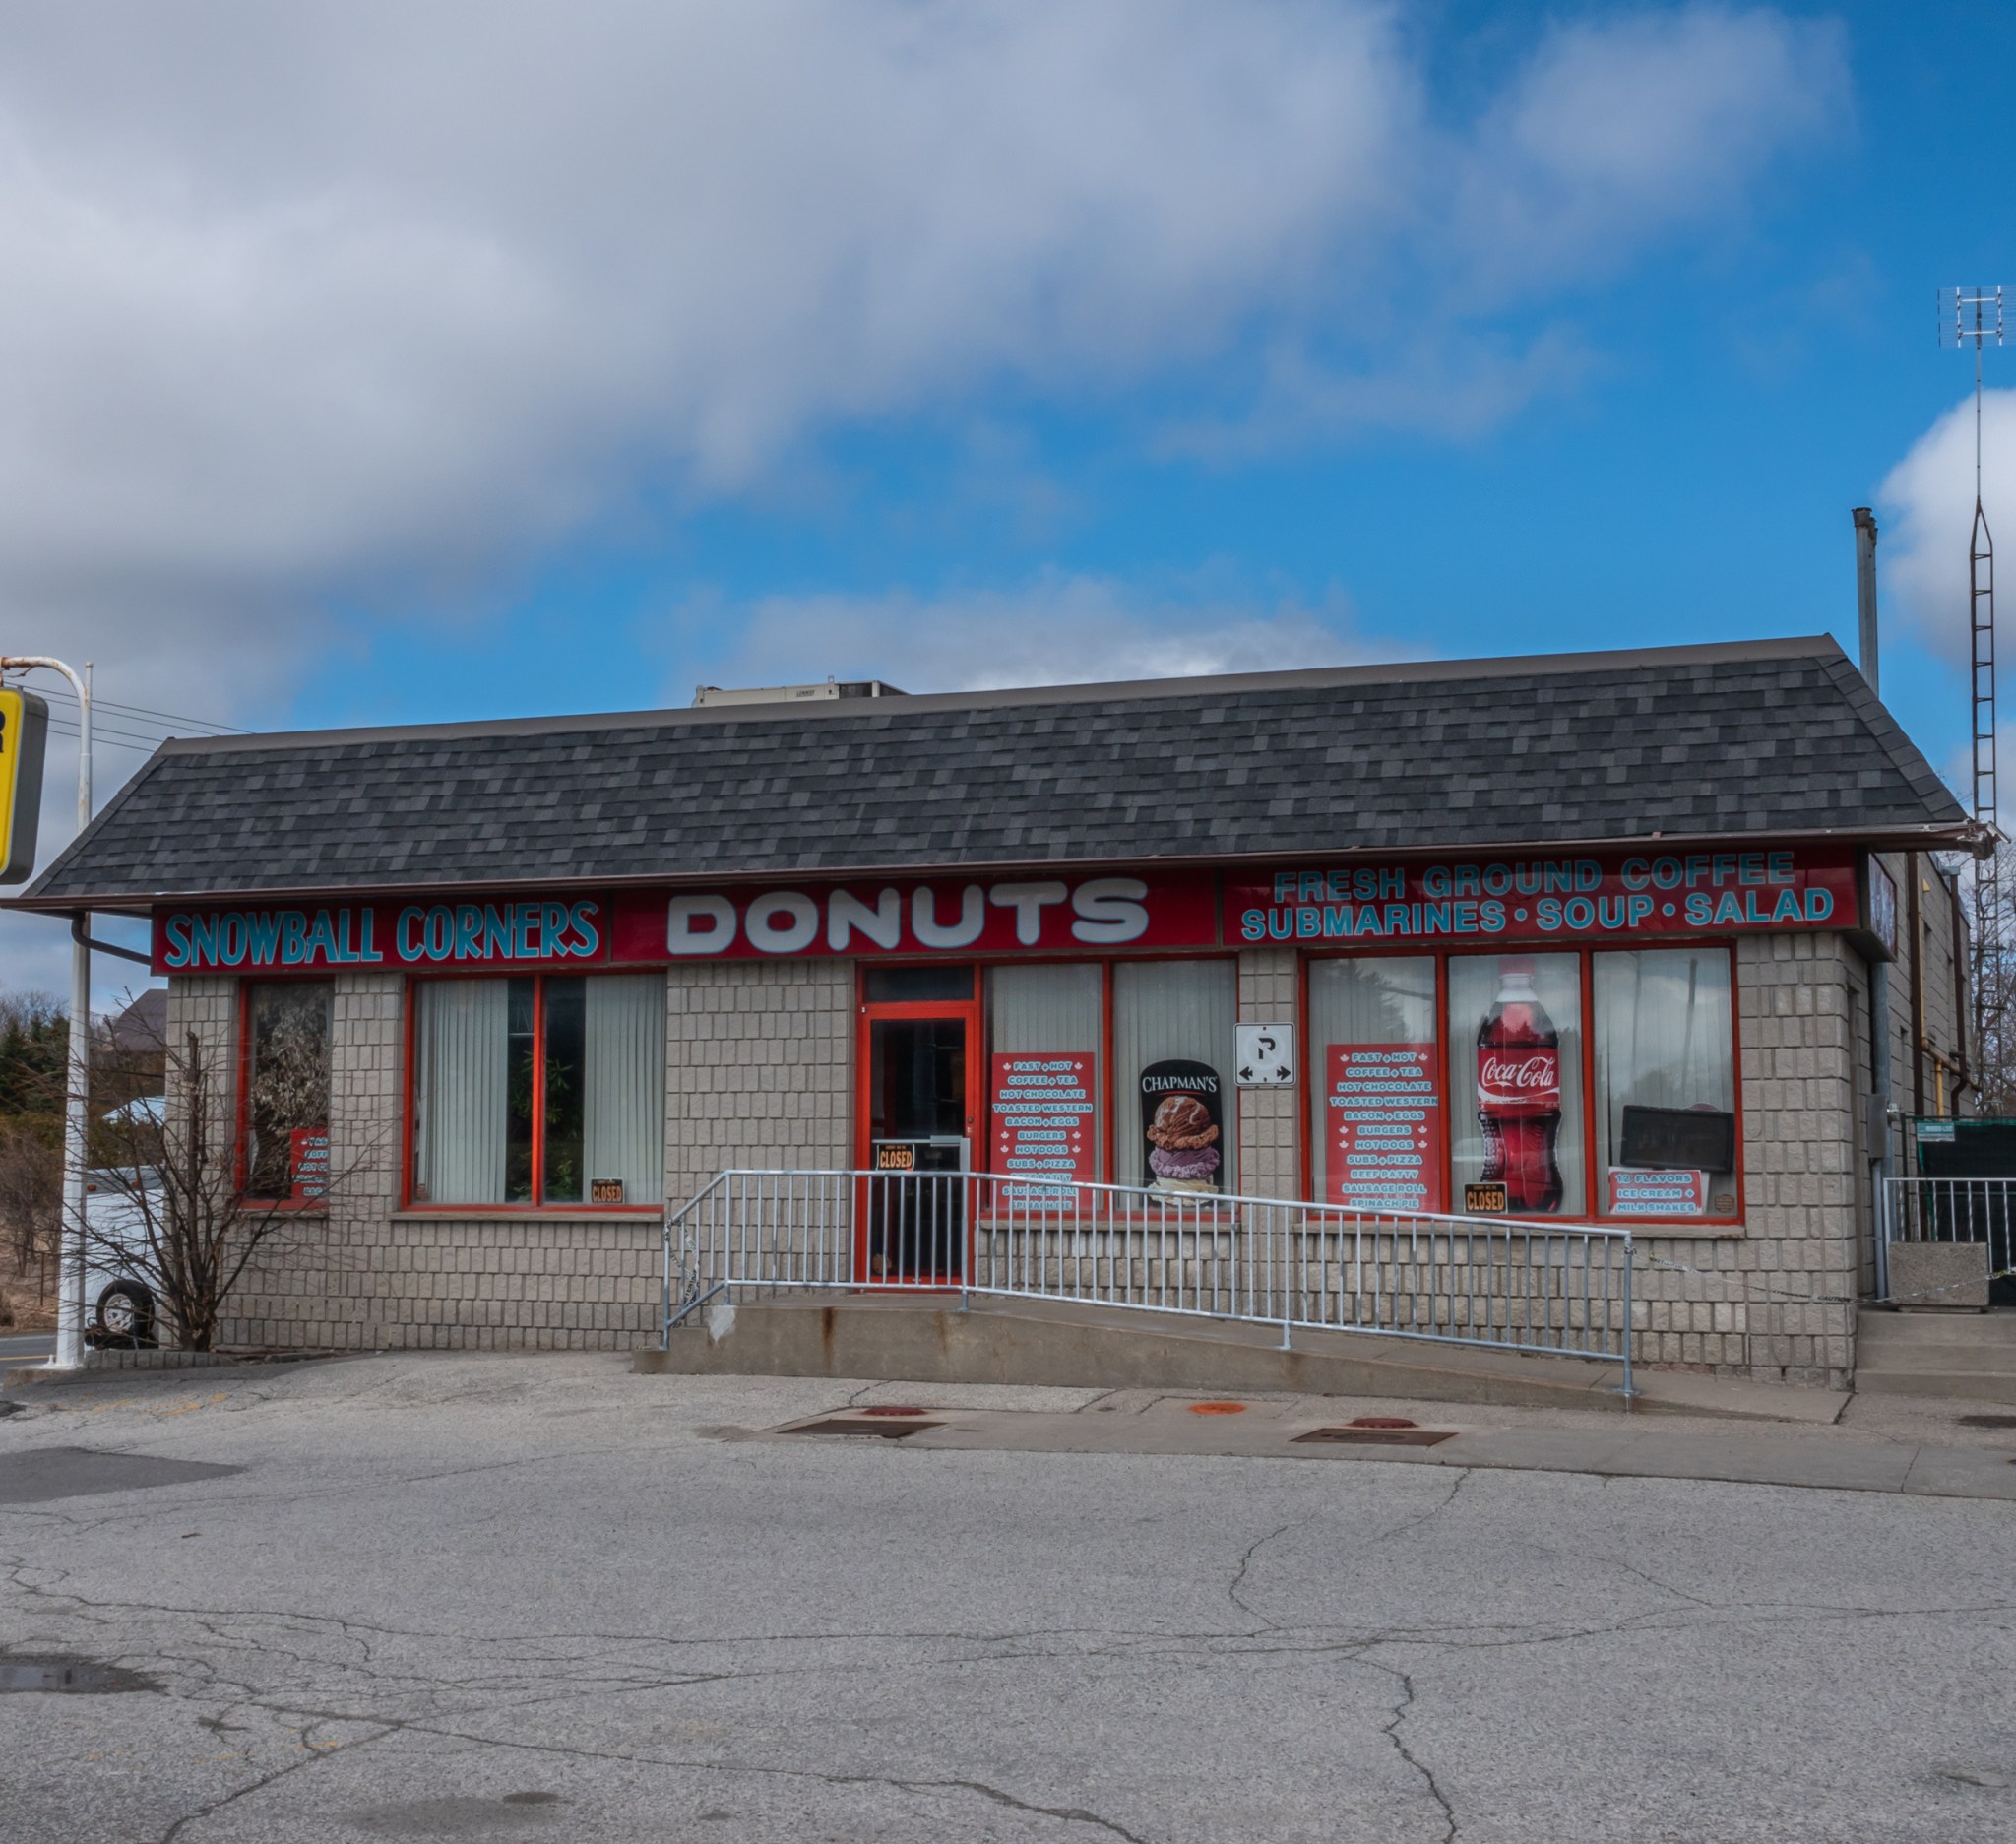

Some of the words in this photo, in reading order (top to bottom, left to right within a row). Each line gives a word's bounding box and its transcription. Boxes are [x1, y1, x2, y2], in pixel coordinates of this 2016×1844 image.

[1274, 867, 1405, 903] FRESH
[1423, 858, 1603, 898] GROUND
[1621, 851, 1796, 891] COFFEE
[666, 877, 1150, 955] DONUTS
[1241, 899, 1507, 940] SUBMARINES
[1536, 894, 1654, 930] SOUP
[1684, 887, 1834, 926] SALAD
[164, 907, 383, 967] SNOWBALL
[396, 901, 599, 962] CORNERS
[1352, 1053, 1382, 1062] FAST
[1391, 1053, 1417, 1062] HOT
[1013, 1062, 1041, 1071] FAST
[1049, 1062, 1072, 1071] HOT
[1481, 1056, 1555, 1087] Coca-Cola
[1346, 1067, 1389, 1077] COFFEE
[1400, 1067, 1423, 1077] TEA
[1008, 1076, 1048, 1085] COFFEE
[1057, 1076, 1078, 1085] TEA
[1142, 1076, 1217, 1093] CHAPMAN'S
[1337, 1082, 1361, 1091] HOT
[1362, 1082, 1432, 1091] CHOCOLATE
[1000, 1090, 1024, 1099] HOT
[1024, 1090, 1085, 1099] CHOCOLATE
[1330, 1097, 1383, 1106] TOASTED
[1384, 1097, 1438, 1106] WESTERN
[993, 1104, 1041, 1113] TOASTED
[1042, 1104, 1093, 1113] WESTERN
[1344, 1111, 1383, 1120] BACON
[1393, 1111, 1425, 1120] EGGS
[1005, 1117, 1041, 1127] BACON
[1050, 1117, 1079, 1126] EGGS
[1018, 1131, 1066, 1140] BURGERS
[1357, 1126, 1411, 1135] BURGERS
[1015, 1145, 1038, 1154] HOT
[1039, 1145, 1068, 1154] DOGS
[1355, 1140, 1381, 1149] HOT
[1381, 1140, 1414, 1149] DOGS
[880, 1150, 912, 1168] CLOSED
[1007, 1159, 1036, 1168] SUBS
[1044, 1159, 1076, 1168] PIZZA
[1347, 1155, 1378, 1164] SUBS
[1387, 1155, 1422, 1164] PIZZA
[1351, 1170, 1380, 1179] BEEF
[1381, 1170, 1418, 1179] PATTY
[1615, 1174, 1630, 1184] 12
[1635, 1174, 1692, 1184] FLAVORS
[592, 1185, 622, 1201] CLOSED
[1342, 1184, 1396, 1194] SAUSAGE
[1397, 1184, 1427, 1194] ROLL
[1617, 1188, 1638, 1199] ICE
[1639, 1188, 1682, 1199] CREAM
[1350, 1199, 1401, 1209] SPINACH
[1401, 1199, 1419, 1208] PIE
[1467, 1191, 1504, 1210] CLOSED
[1616, 1202, 1646, 1212] MILK
[1646, 1202, 1697, 1212] SHAKES
